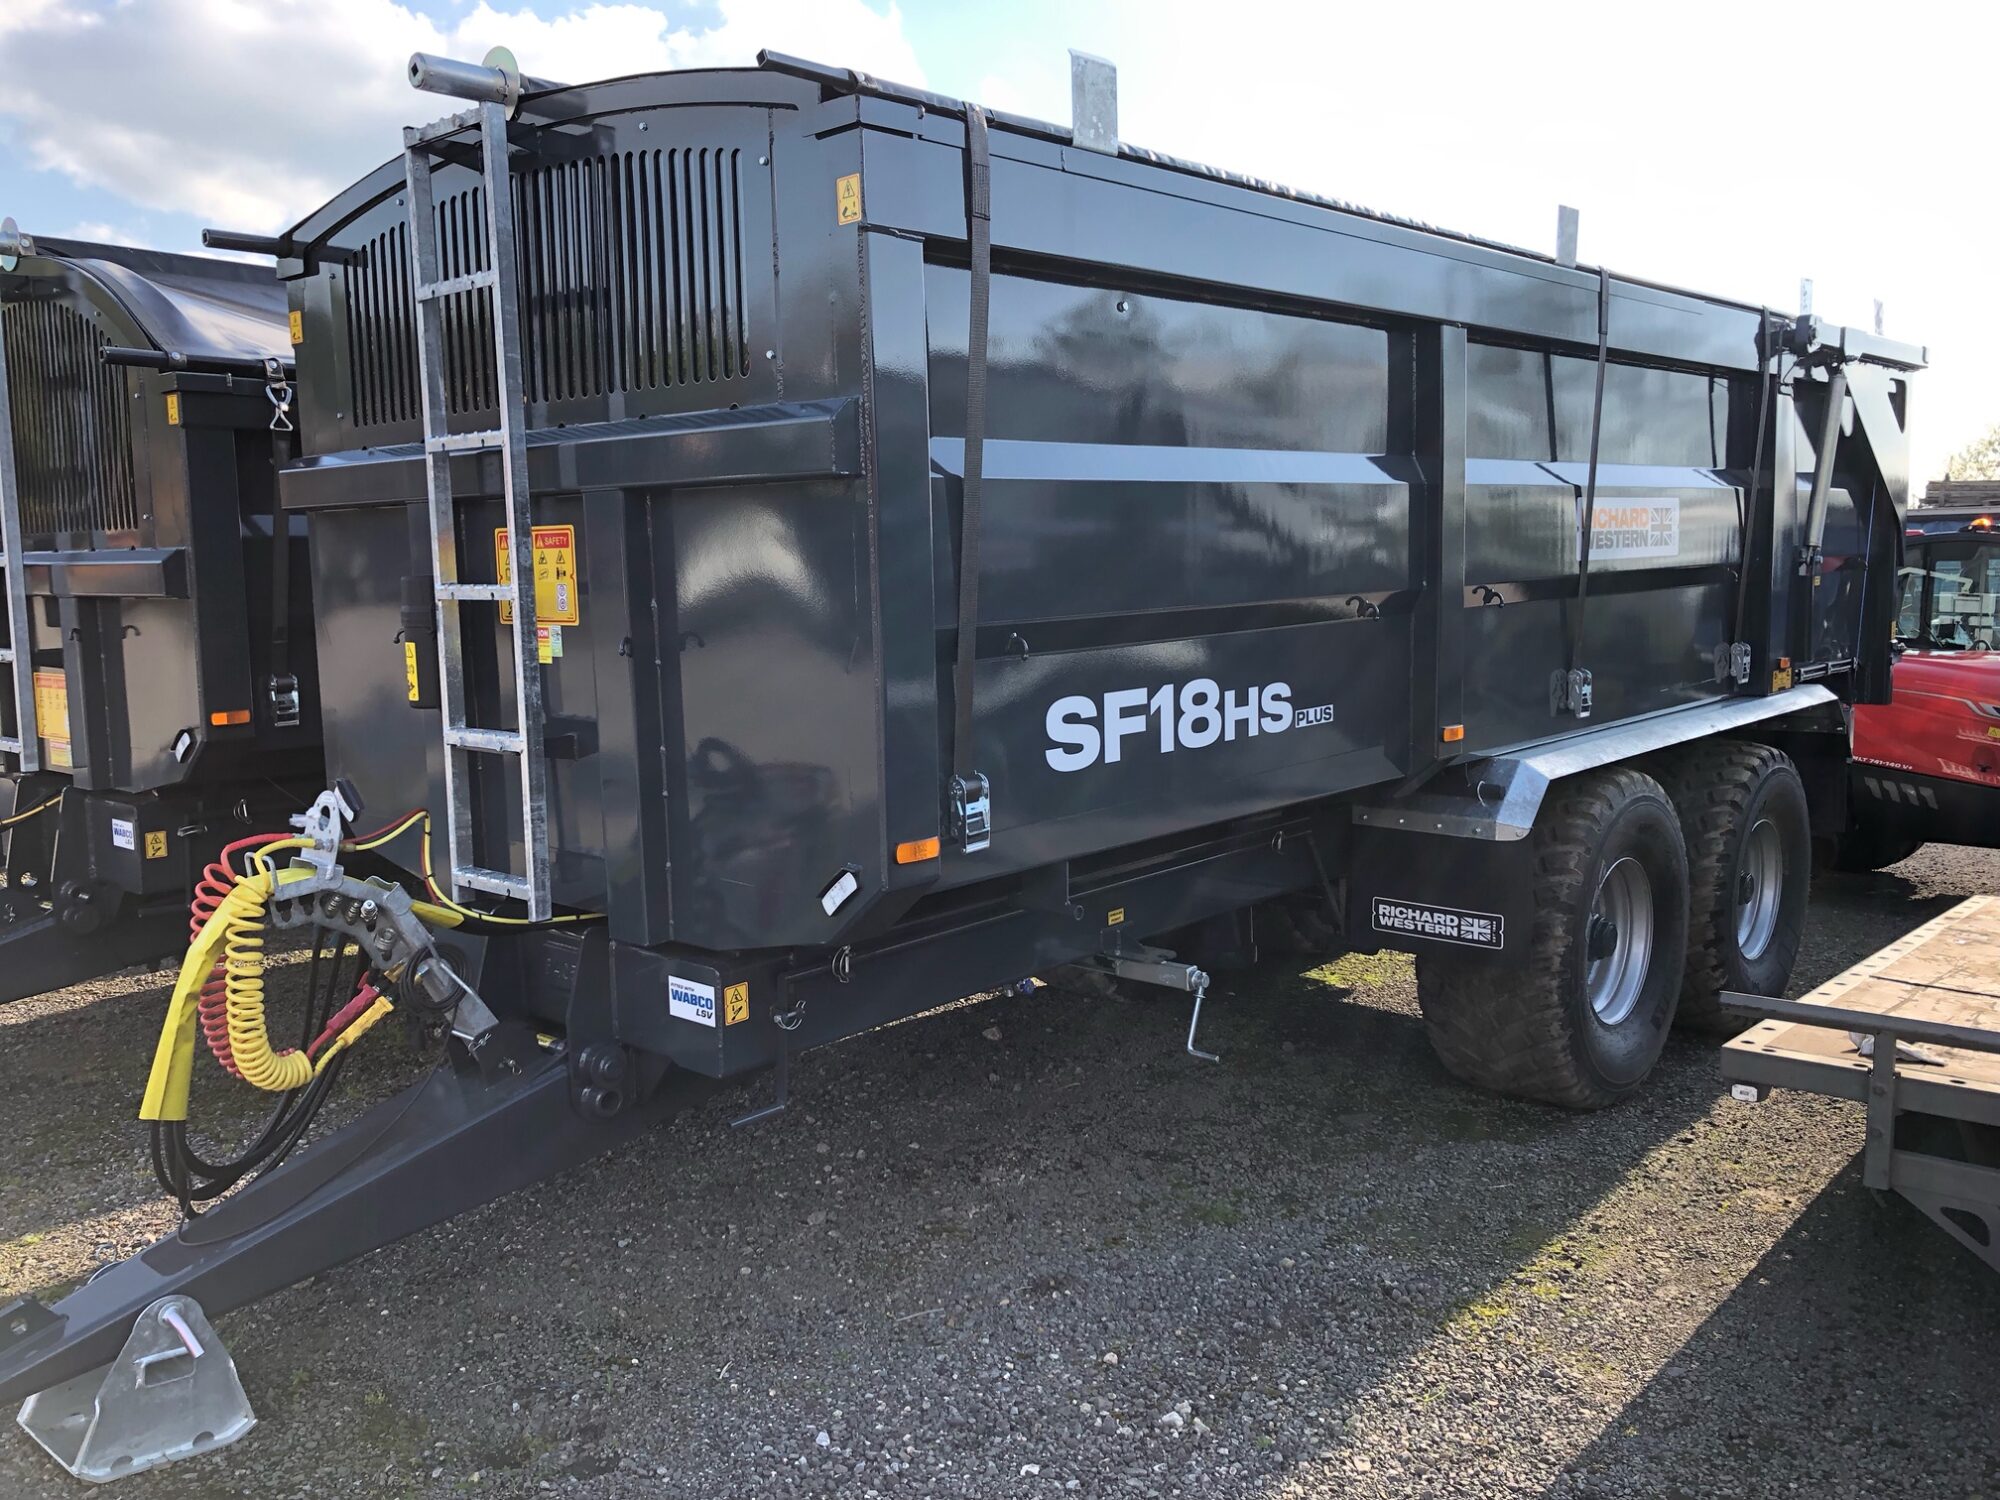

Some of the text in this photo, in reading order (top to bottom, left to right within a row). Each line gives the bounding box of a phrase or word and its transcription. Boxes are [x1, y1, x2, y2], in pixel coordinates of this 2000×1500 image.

[1592, 508, 1649, 528] ICHARD
[544, 536, 567, 546] SAFETY
[1045, 678, 1333, 772] SF18HS PLUS
[1379, 904, 1459, 926] RICHARD
[1379, 915, 1458, 937] WESTERN
[671, 988, 713, 1010] WABCO
[696, 1008, 713, 1019] LSV
